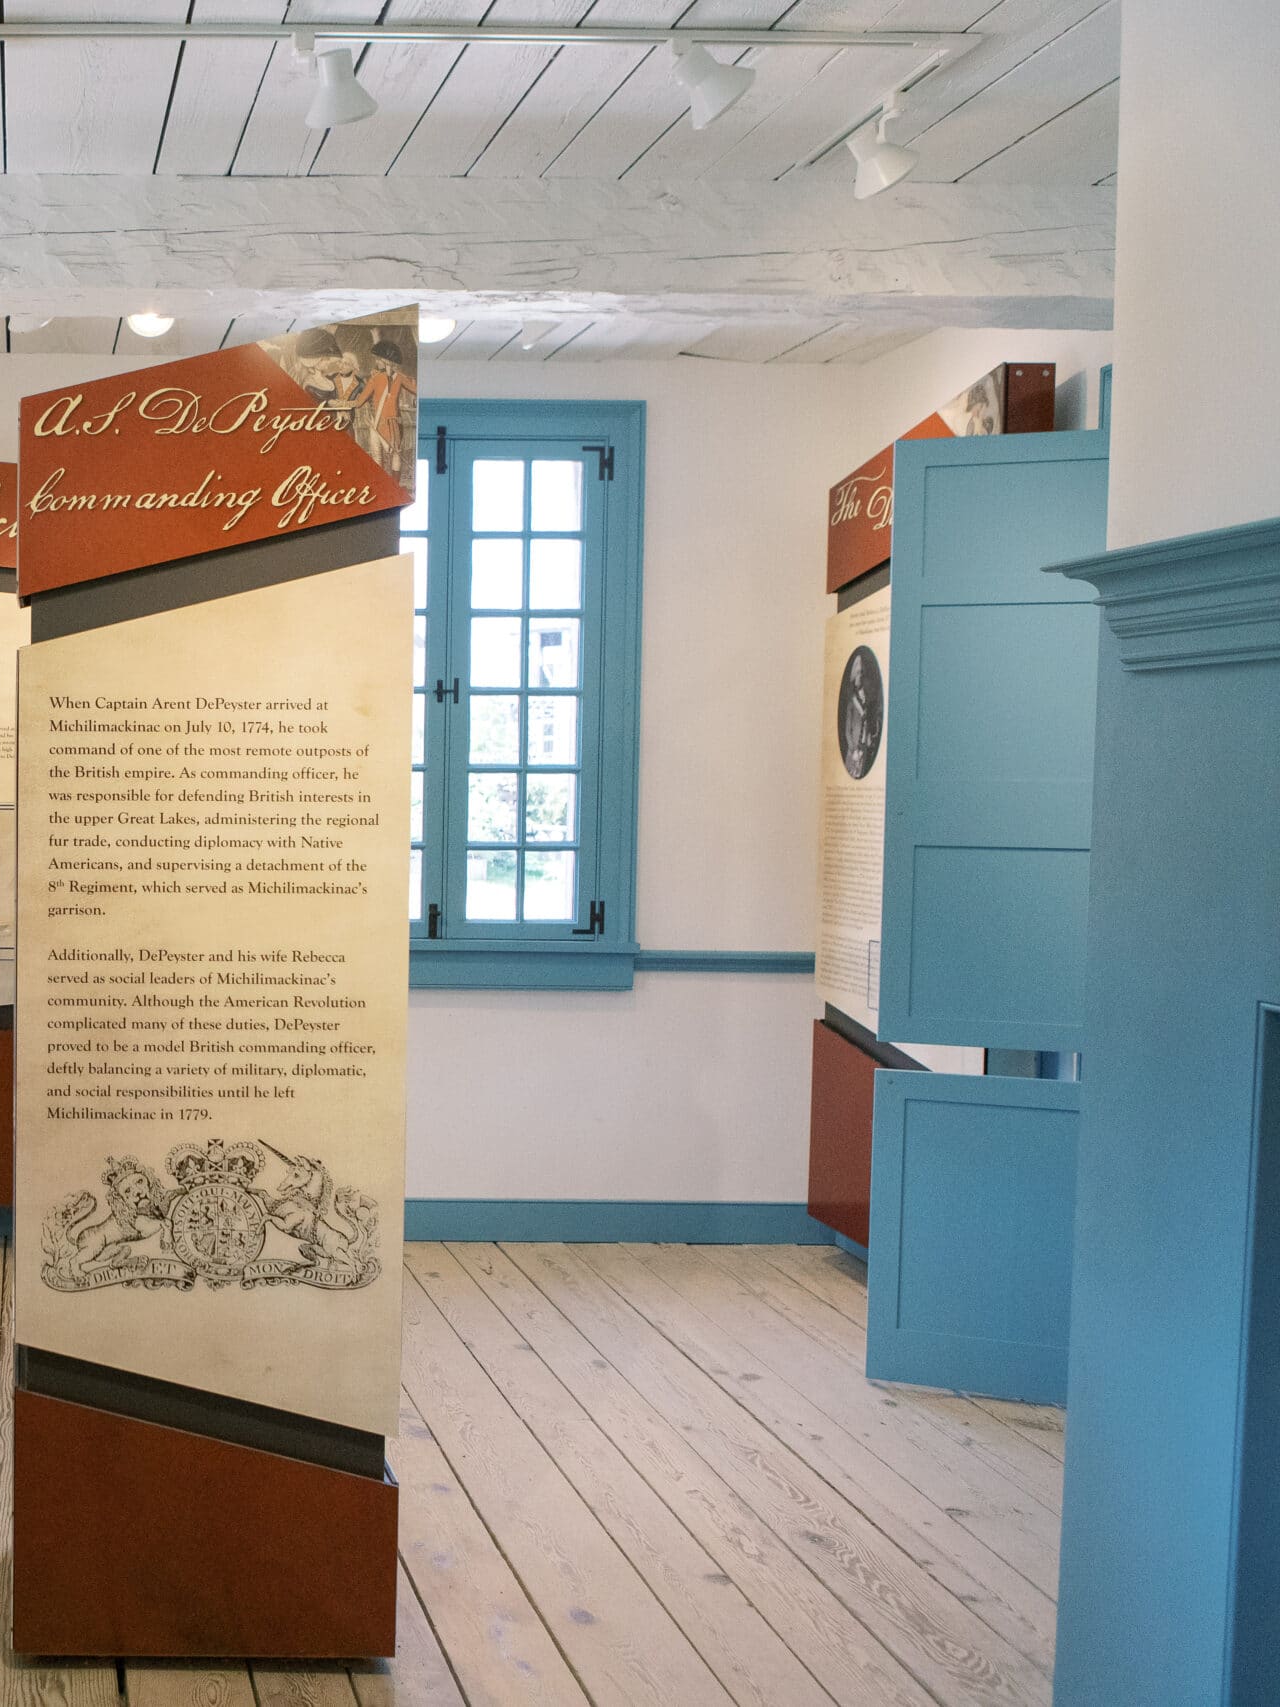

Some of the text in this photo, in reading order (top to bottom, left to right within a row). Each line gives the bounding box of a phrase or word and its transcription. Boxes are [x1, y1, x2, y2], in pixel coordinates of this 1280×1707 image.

[25, 465, 377, 531] Commanding Officer
[48, 695, 329, 713] When Captain Arent DePeyster arrived at
[48, 718, 329, 737] Michilimackinac on July 10, 1774, he took
[48, 741, 370, 760] command of one of the most remote outposts of
[49, 764, 360, 784] the British empire. As commanding officer, he
[48, 788, 372, 806] was responsible for defending British interests in
[48, 810, 380, 830] the upper Great Lakes, administering the regional
[48, 833, 344, 851] fur trade, conducting diplomacy with Native
[47, 856, 368, 875] Americans, and supervising a detachment of the
[47, 879, 368, 896] 8th Regiment, which served as Michilimackinac's
[47, 903, 106, 919] garrison.
[47, 947, 346, 965] Additionally, DePeyster and his wife Rebecca
[47, 970, 337, 987] served as social leaders of Michilimackinac's
[47, 993, 366, 1011] community. Although the American Revolution
[46, 1015, 341, 1034] complicated many of these duties, DePeyster
[47, 1038, 376, 1056] proved to be a model British commanding officer,
[46, 1060, 367, 1079] deftly balancing a variety of military, diplomatic,
[46, 1084, 296, 1100] and social responsibilities until he left
[46, 1106, 213, 1121] Michilimackinac in 1779.
